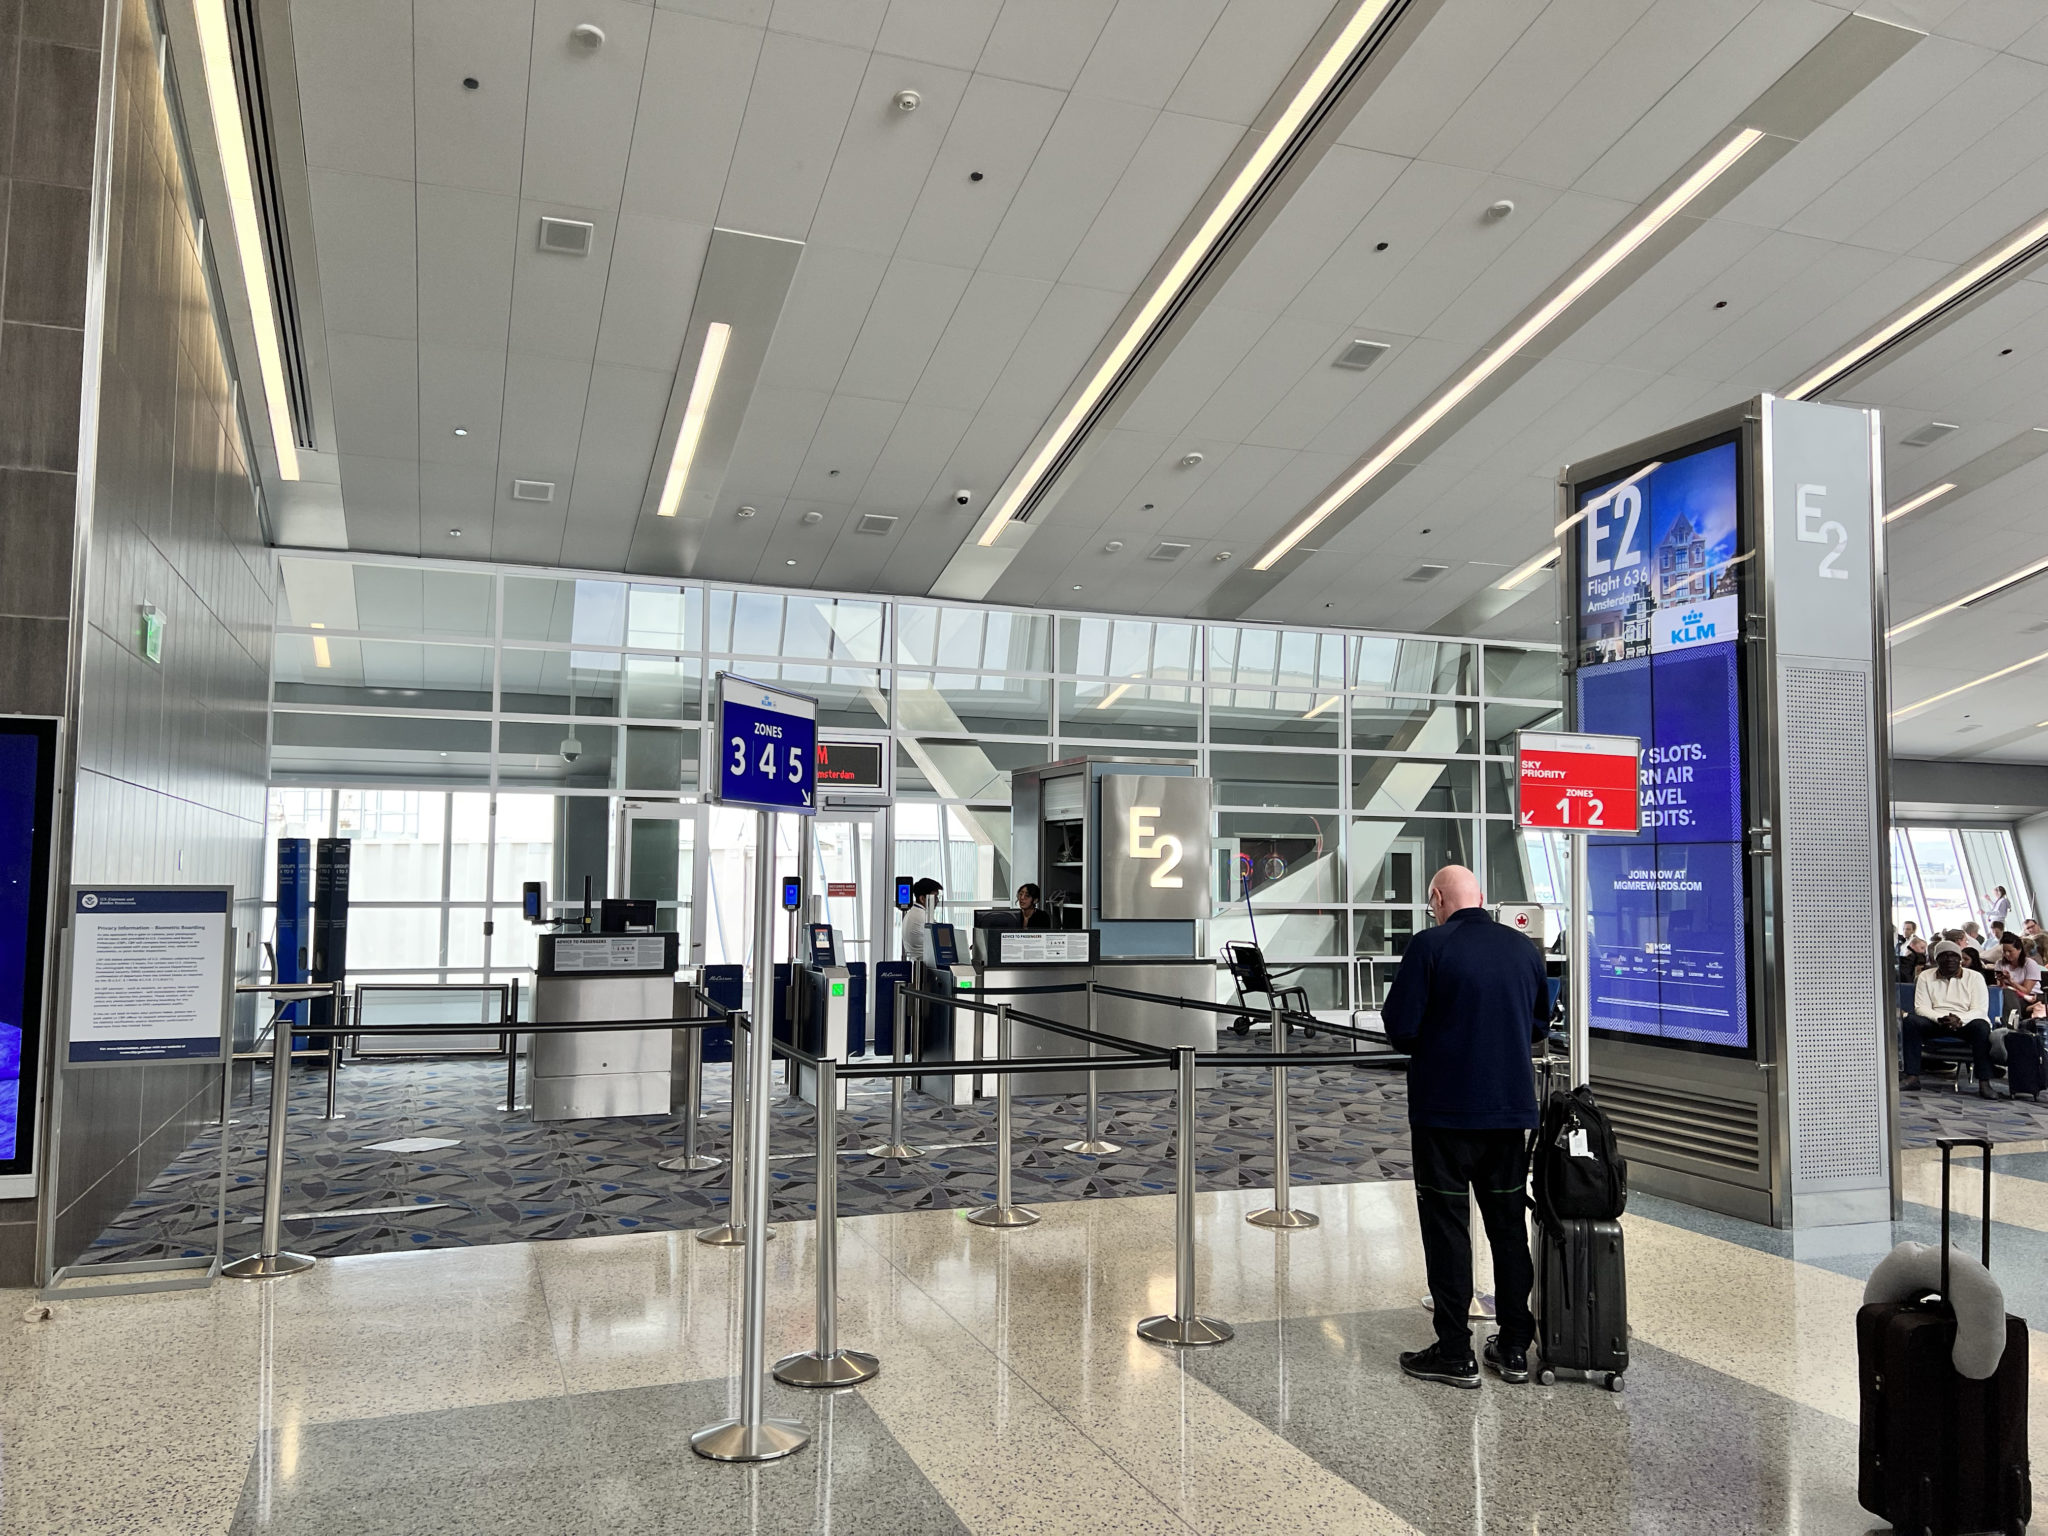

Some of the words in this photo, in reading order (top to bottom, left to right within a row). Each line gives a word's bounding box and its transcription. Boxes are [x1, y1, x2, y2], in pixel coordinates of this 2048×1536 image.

[1587, 485, 1642, 578] E2
[1797, 483, 1849, 579] E2
[1587, 575, 1620, 597] Flight
[1624, 566, 1648, 587] 636
[1587, 592, 1640, 613] Amsterdam
[1671, 623, 1715, 644] KLM
[754, 722, 783, 739] ZONES
[730, 736, 746, 776] 3
[758, 742, 776, 780] 4
[788, 747, 803, 783] 5
[817, 745, 828, 765] M
[1649, 743, 1707, 765] SLOTS.
[817, 769, 855, 780] msterdam
[1521, 760, 1541, 769] SKY
[1521, 769, 1566, 779] PRIORITY
[1640, 768, 1662, 786] RN
[1665, 766, 1694, 784] AIR
[1566, 788, 1594, 798] ZONES
[1640, 788, 1687, 807] RAVEL
[1556, 798, 1570, 825] 1
[1587, 798, 1604, 826] 2
[1130, 806, 1183, 888] E2
[1628, 870, 1648, 880] JOIN
[1650, 870, 1673, 880] NOW
[1674, 870, 1686, 880] AT
[1614, 881, 1703, 891] MGMREWARDS.COM
[1655, 943, 1671, 951] MGM
